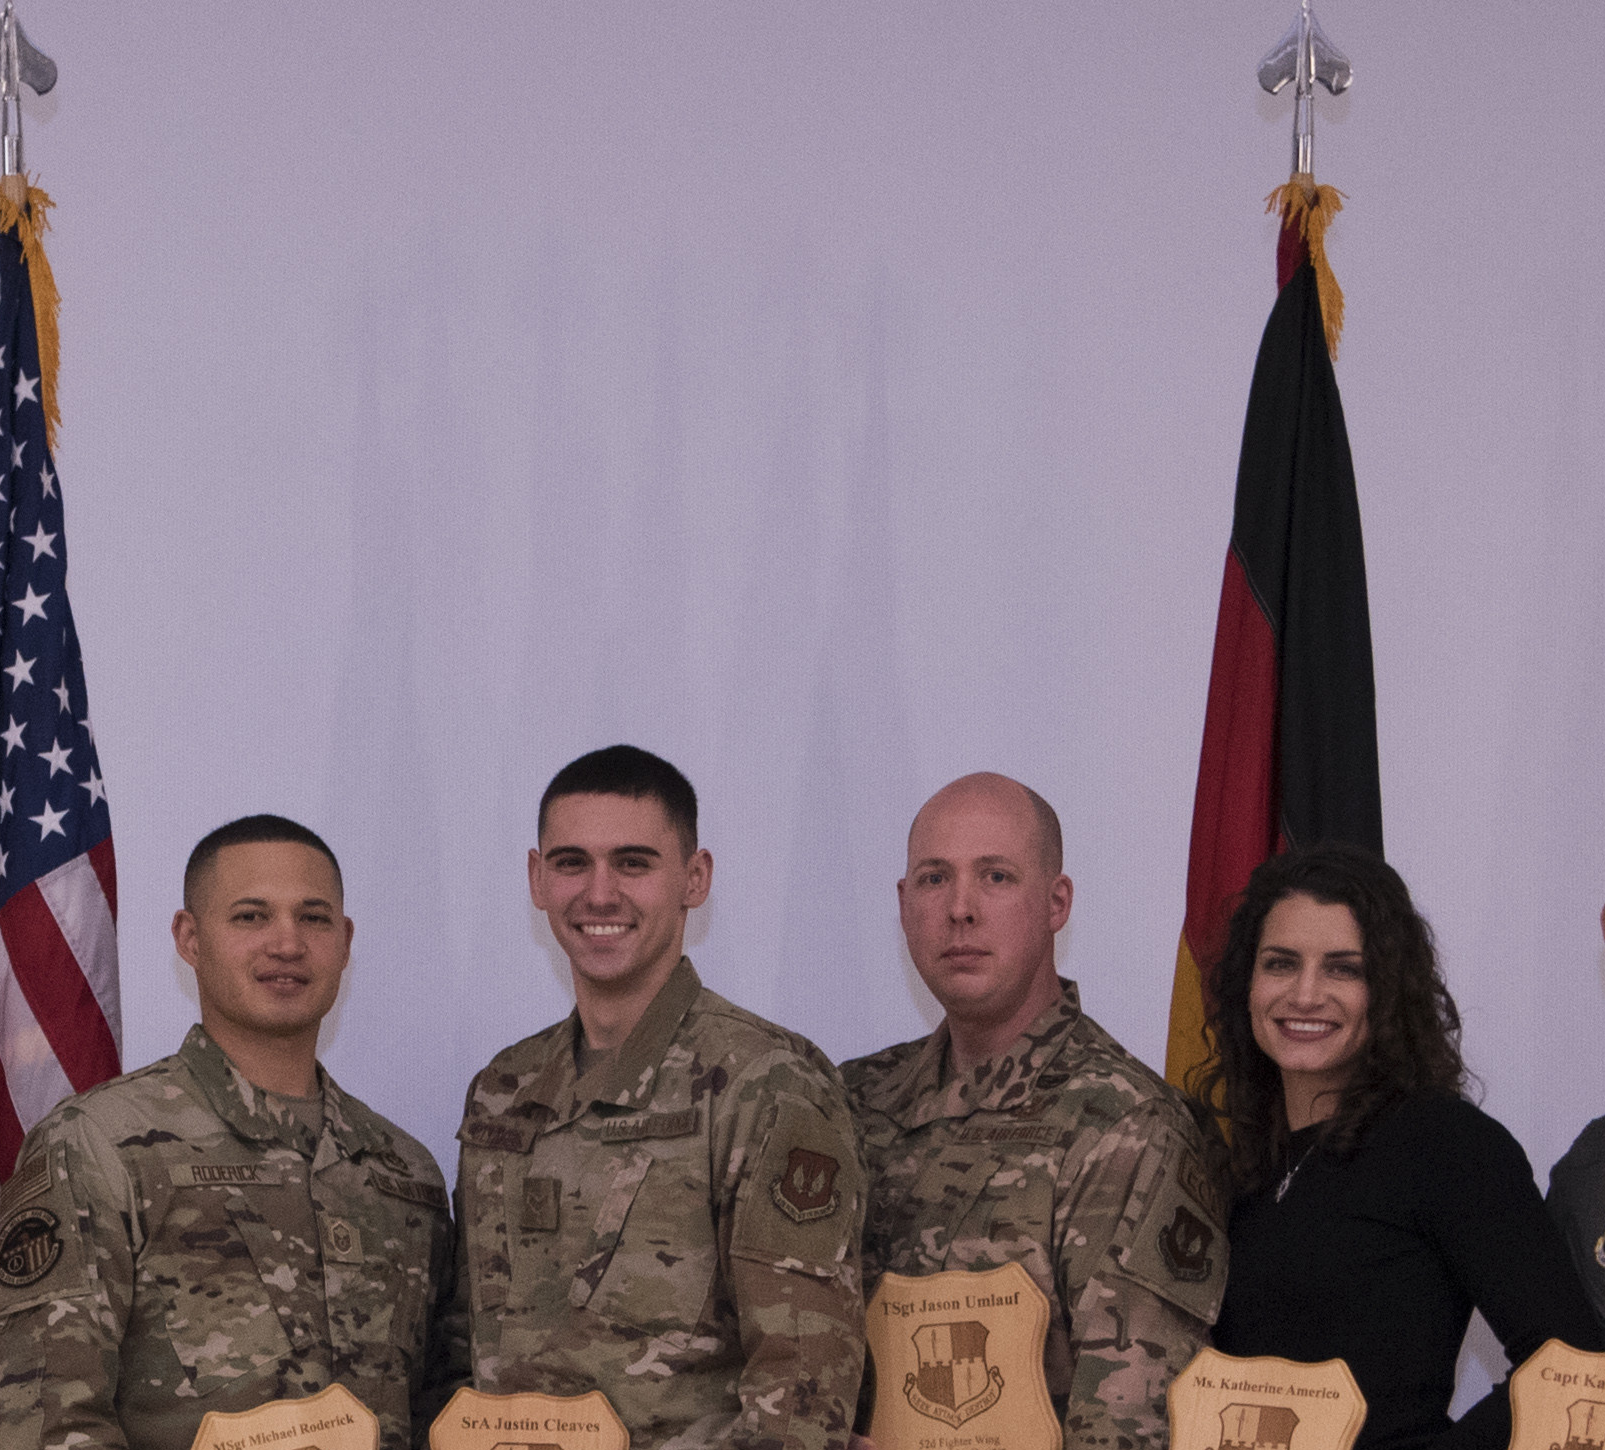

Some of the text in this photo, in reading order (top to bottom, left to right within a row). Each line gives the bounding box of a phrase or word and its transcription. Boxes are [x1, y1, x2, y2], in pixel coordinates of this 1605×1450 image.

[1009, 1125, 1057, 1141] FORCE
[191, 1163, 261, 1183] RODERICK
[881, 1292, 1020, 1318] TSgt Jason Umlauf
[1541, 1367, 1578, 1386] Capt
[1193, 1376, 1340, 1399] Ms. Katherine Americo
[249, 1429, 296, 1447] Michael
[300, 1413, 354, 1434] Roderick
[461, 1416, 600, 1432] SrA Justin Cleaves
